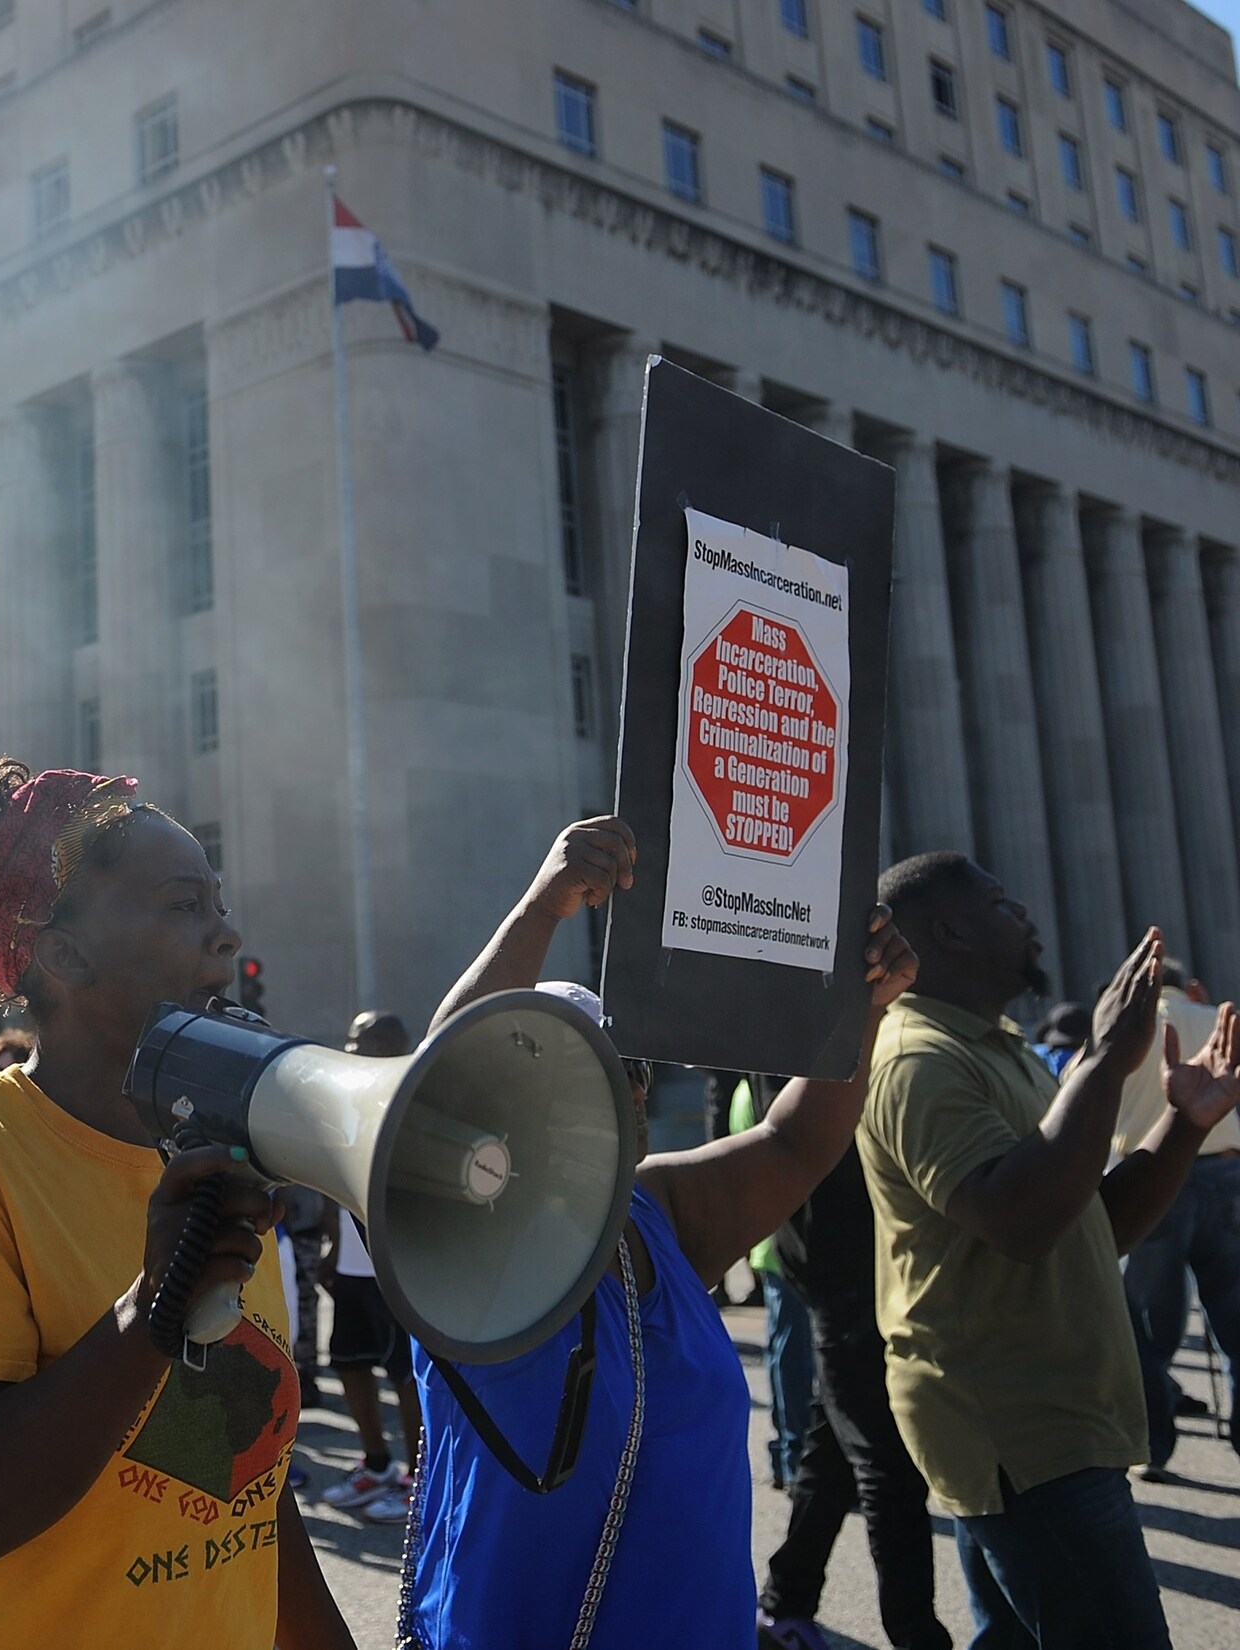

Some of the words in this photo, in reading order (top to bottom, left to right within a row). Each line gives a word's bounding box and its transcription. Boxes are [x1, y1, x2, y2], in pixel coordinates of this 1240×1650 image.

[694, 539, 842, 612] StopMassIncarceration.net
[751, 615, 787, 651] Mass
[716, 634, 819, 692] Incarceration,
[718, 664, 765, 701] Police
[767, 679, 815, 717] Terror,
[693, 685, 778, 733] Repression
[781, 714, 809, 742] and
[812, 718, 835, 748] the
[699, 718, 809, 771] Criminalization
[813, 750, 827, 775] of
[714, 756, 725, 779] a
[728, 755, 809, 799] Generation
[732, 790, 770, 819] must
[772, 795, 789, 823] be
[725, 813, 794, 852] STOPPED!
[701, 885, 811, 923] @StopMassIncNet
[672, 910, 689, 927] FB:
[690, 916, 830, 950] stopmassincarcerationnetwork
[118, 1465, 170, 1504] ONE
[178, 1489, 220, 1526] GOD
[231, 1472, 277, 1517] ONE
[125, 1544, 190, 1587] ONE
[205, 1520, 277, 1570] DESTI
